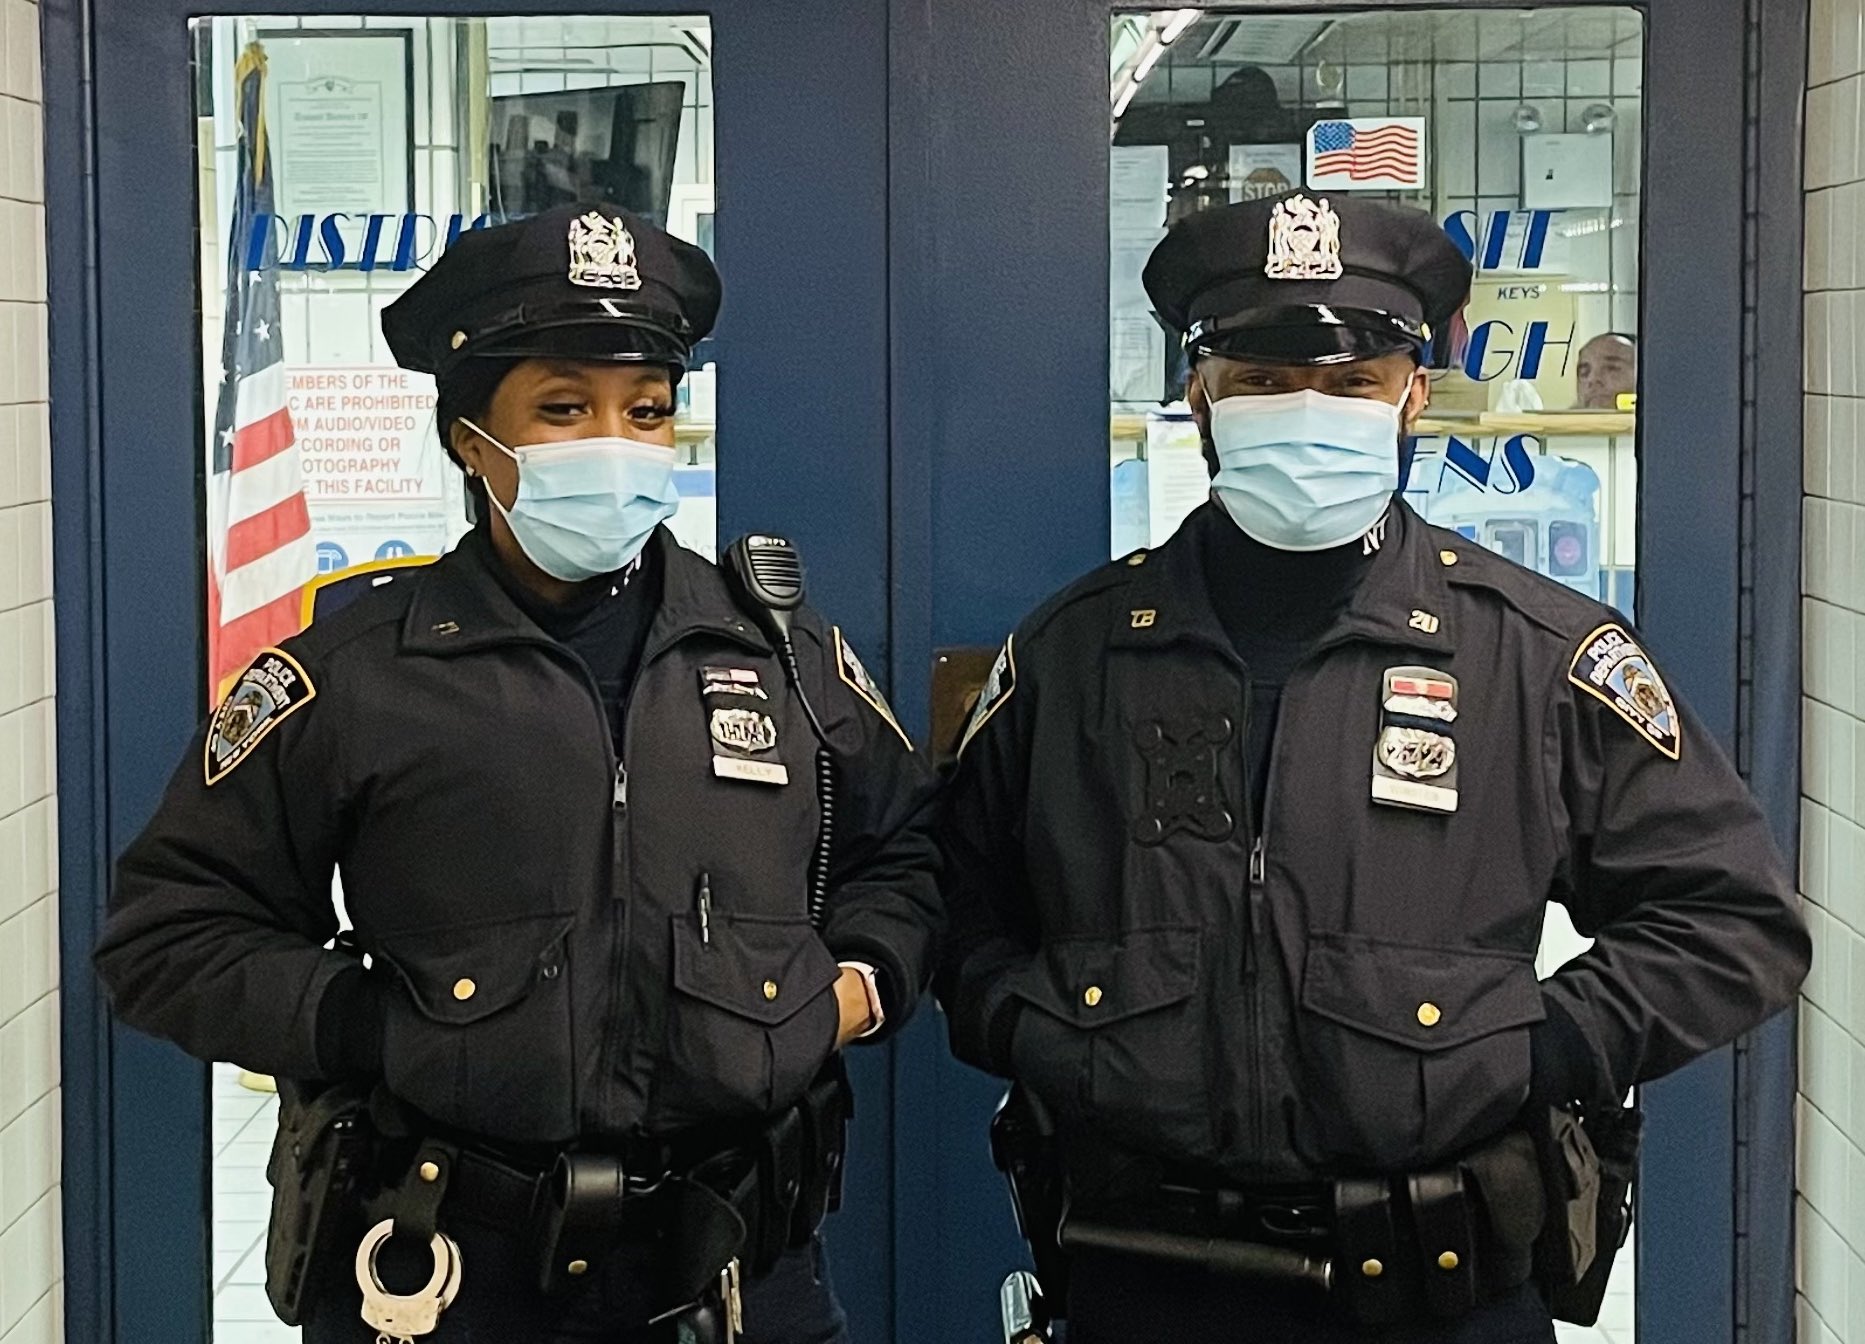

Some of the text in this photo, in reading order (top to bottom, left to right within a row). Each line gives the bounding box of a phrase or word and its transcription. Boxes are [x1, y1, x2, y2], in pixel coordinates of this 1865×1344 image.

[244, 213, 490, 271] DISTRI
[1496, 285, 1541, 301] KEYS
[352, 374, 373, 390] OF
[377, 374, 409, 389] THE
[304, 395, 337, 411] ARE
[341, 394, 436, 411] PROHIBITED
[314, 415, 416, 432] AUDIO/VIDEO
[301, 436, 401, 453] CORDING OR
[302, 457, 401, 474] OTOGRAPHY
[315, 478, 351, 495] THIS
[354, 478, 424, 494] FACILITY
